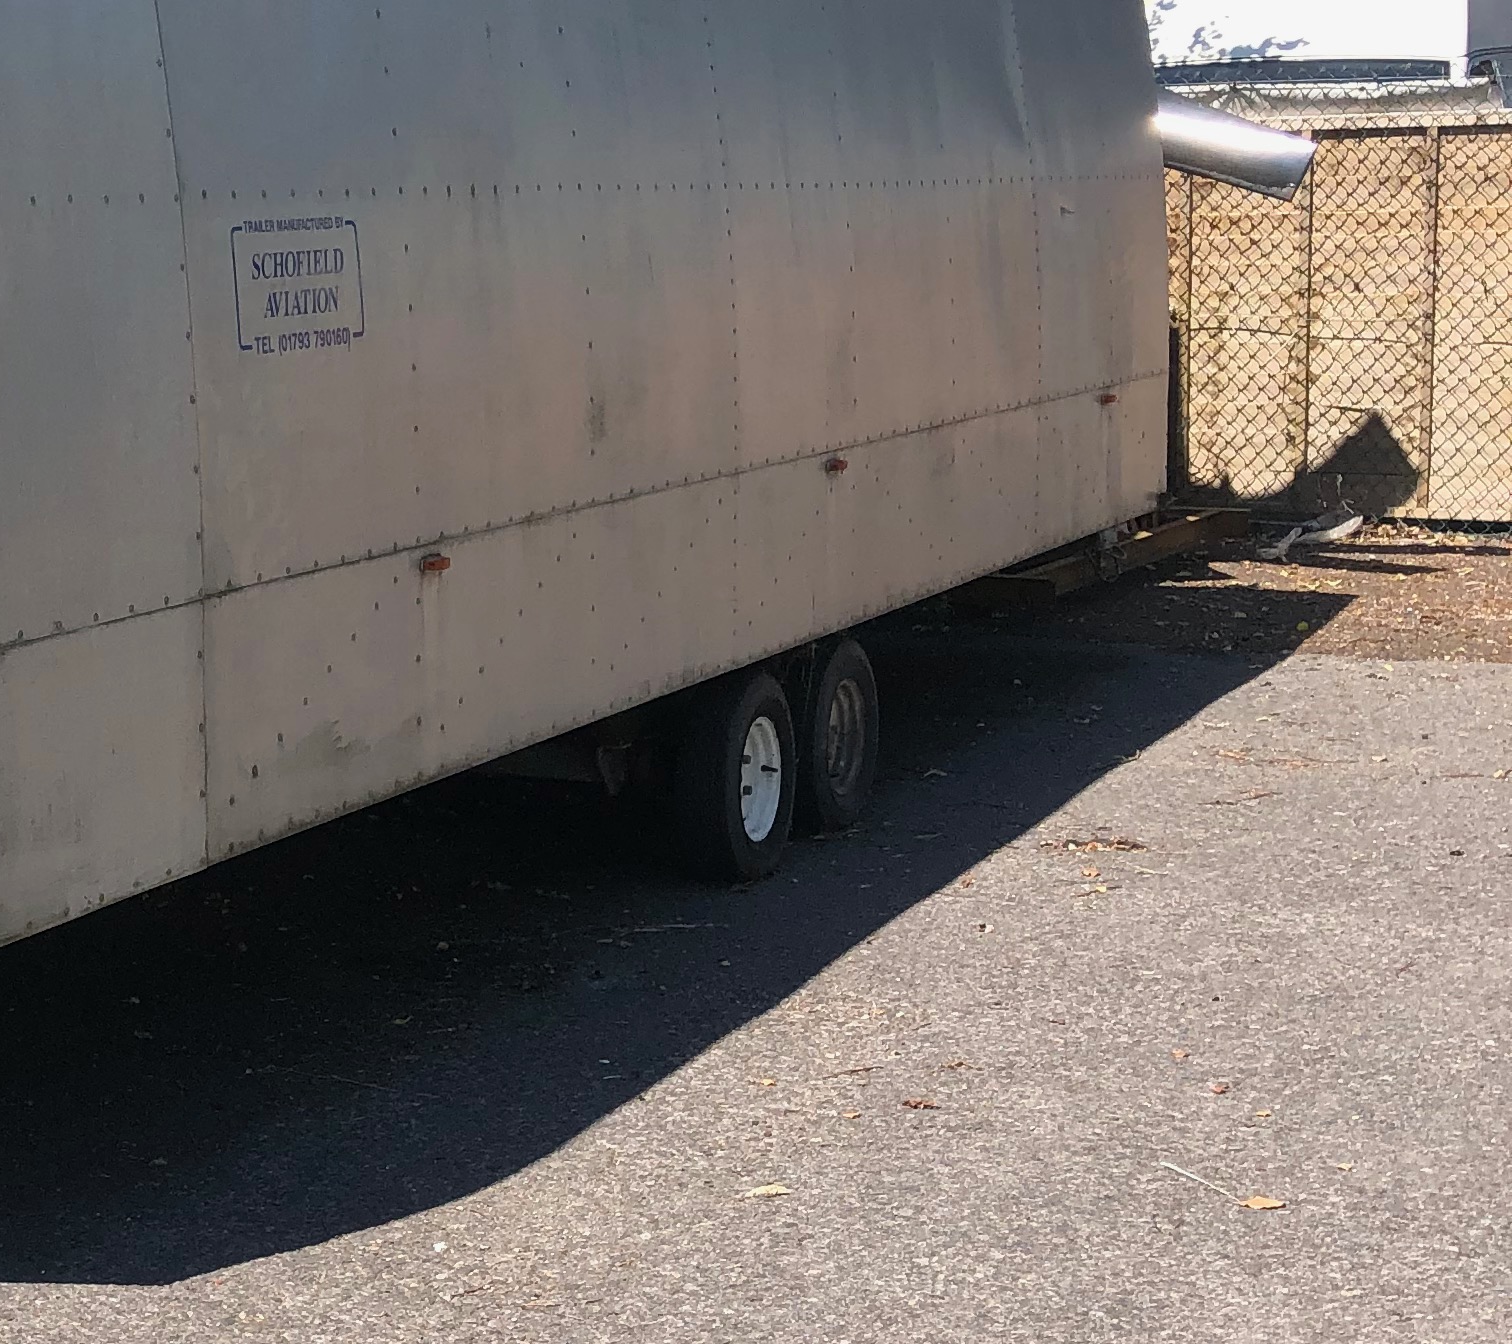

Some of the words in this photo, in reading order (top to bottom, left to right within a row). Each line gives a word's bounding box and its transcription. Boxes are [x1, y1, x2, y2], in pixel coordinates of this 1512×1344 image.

[243, 219, 275, 233] TRAILER
[276, 217, 334, 232] MANUFACTURED
[251, 248, 344, 280] SCHOFIELD
[264, 286, 339, 318] AVIATION
[255, 335, 276, 355] TEL
[278, 331, 311, 356] (01793
[314, 326, 351, 352] 790160)
